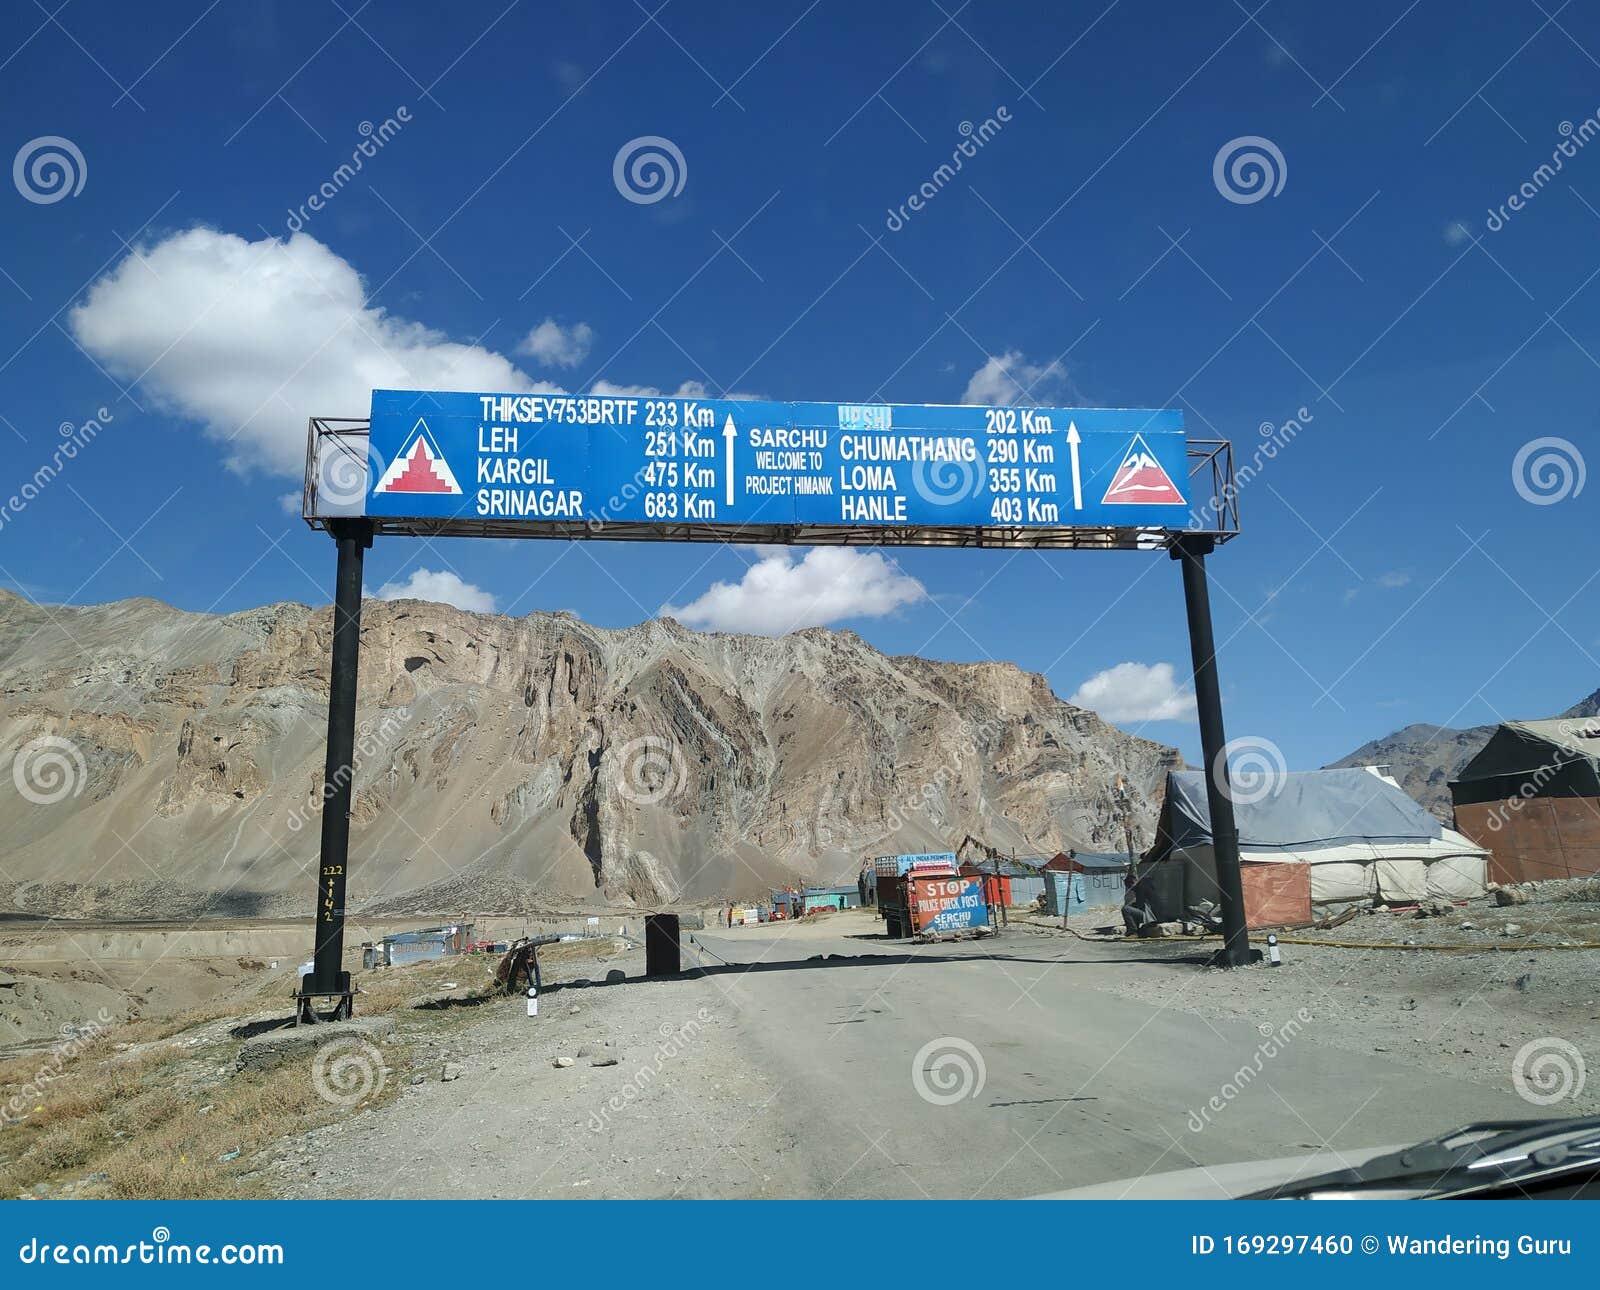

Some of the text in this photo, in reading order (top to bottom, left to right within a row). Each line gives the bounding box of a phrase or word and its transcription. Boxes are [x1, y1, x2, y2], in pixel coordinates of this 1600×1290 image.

[645, 402, 678, 426] 233
[684, 402, 715, 427] Km
[985, 410, 1018, 434] 202
[1022, 411, 1051, 434] Km
[479, 427, 715, 457] LEH 251 Km
[749, 429, 827, 448] SARCHU
[839, 436, 1054, 463] CHUMATHANG 290 Km
[477, 457, 715, 488] KARGIL 475 Km
[756, 451, 822, 470] WELCOME TO
[746, 476, 833, 495] PROJECT HIMANK
[840, 466, 1056, 492] LOMA 355 Km
[476, 489, 716, 519] SRINAGAR 683 Km
[841, 496, 1058, 522] HANLE 403 Km
[323, 866, 343, 875] 222
[927, 881, 969, 896] STOP
[918, 896, 978, 912] POLICE CHECK POST
[934, 911, 971, 924] SERCHU
